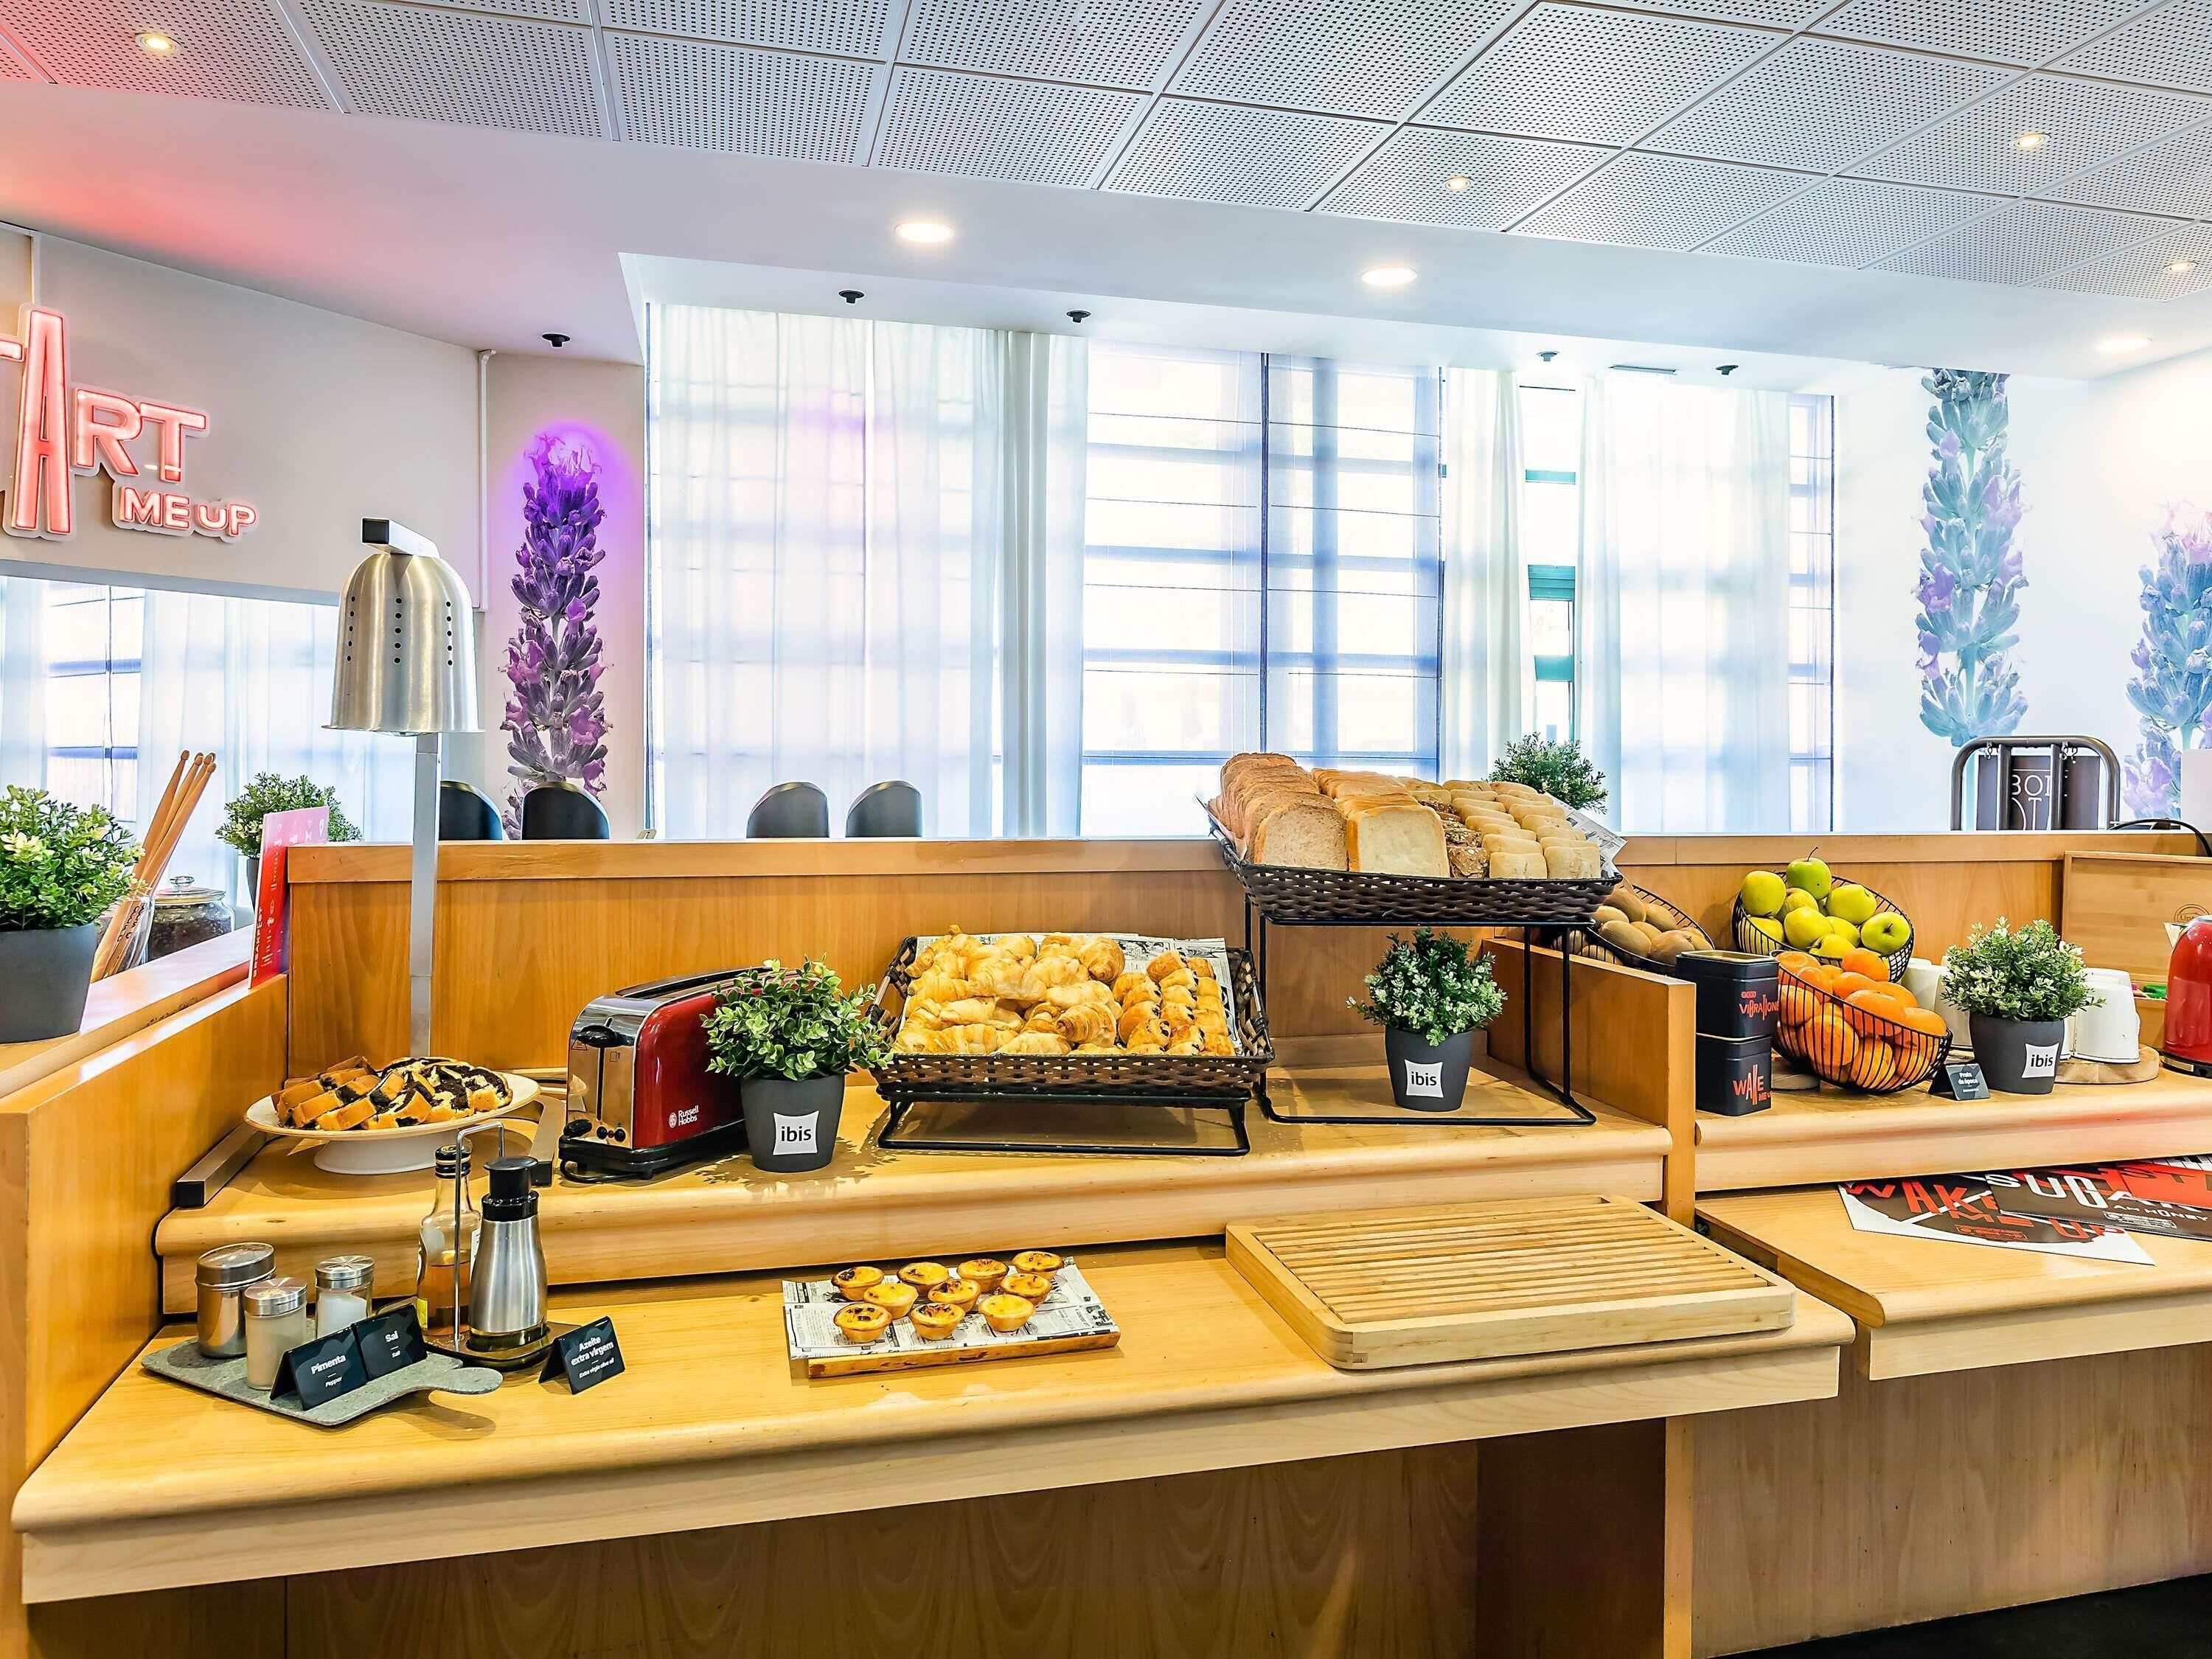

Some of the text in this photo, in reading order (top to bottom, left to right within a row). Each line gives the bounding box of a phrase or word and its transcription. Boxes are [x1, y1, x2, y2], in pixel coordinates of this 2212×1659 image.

[121, 486, 257, 537] ME UP
[2031, 1054, 2053, 1067] ibis
[1411, 1071, 1437, 1086] ibis
[678, 1105, 699, 1119] Russell
[678, 1114, 698, 1127] Hobbs
[781, 1126, 812, 1141] ibis
[2144, 1208, 2208, 1222] HONEY
[385, 1330, 399, 1343] Sal
[579, 1336, 602, 1352] Azeite
[571, 1341, 614, 1366] extra virgem
[310, 1354, 347, 1375] Pimenta
[325, 1376, 343, 1388] Pepper
